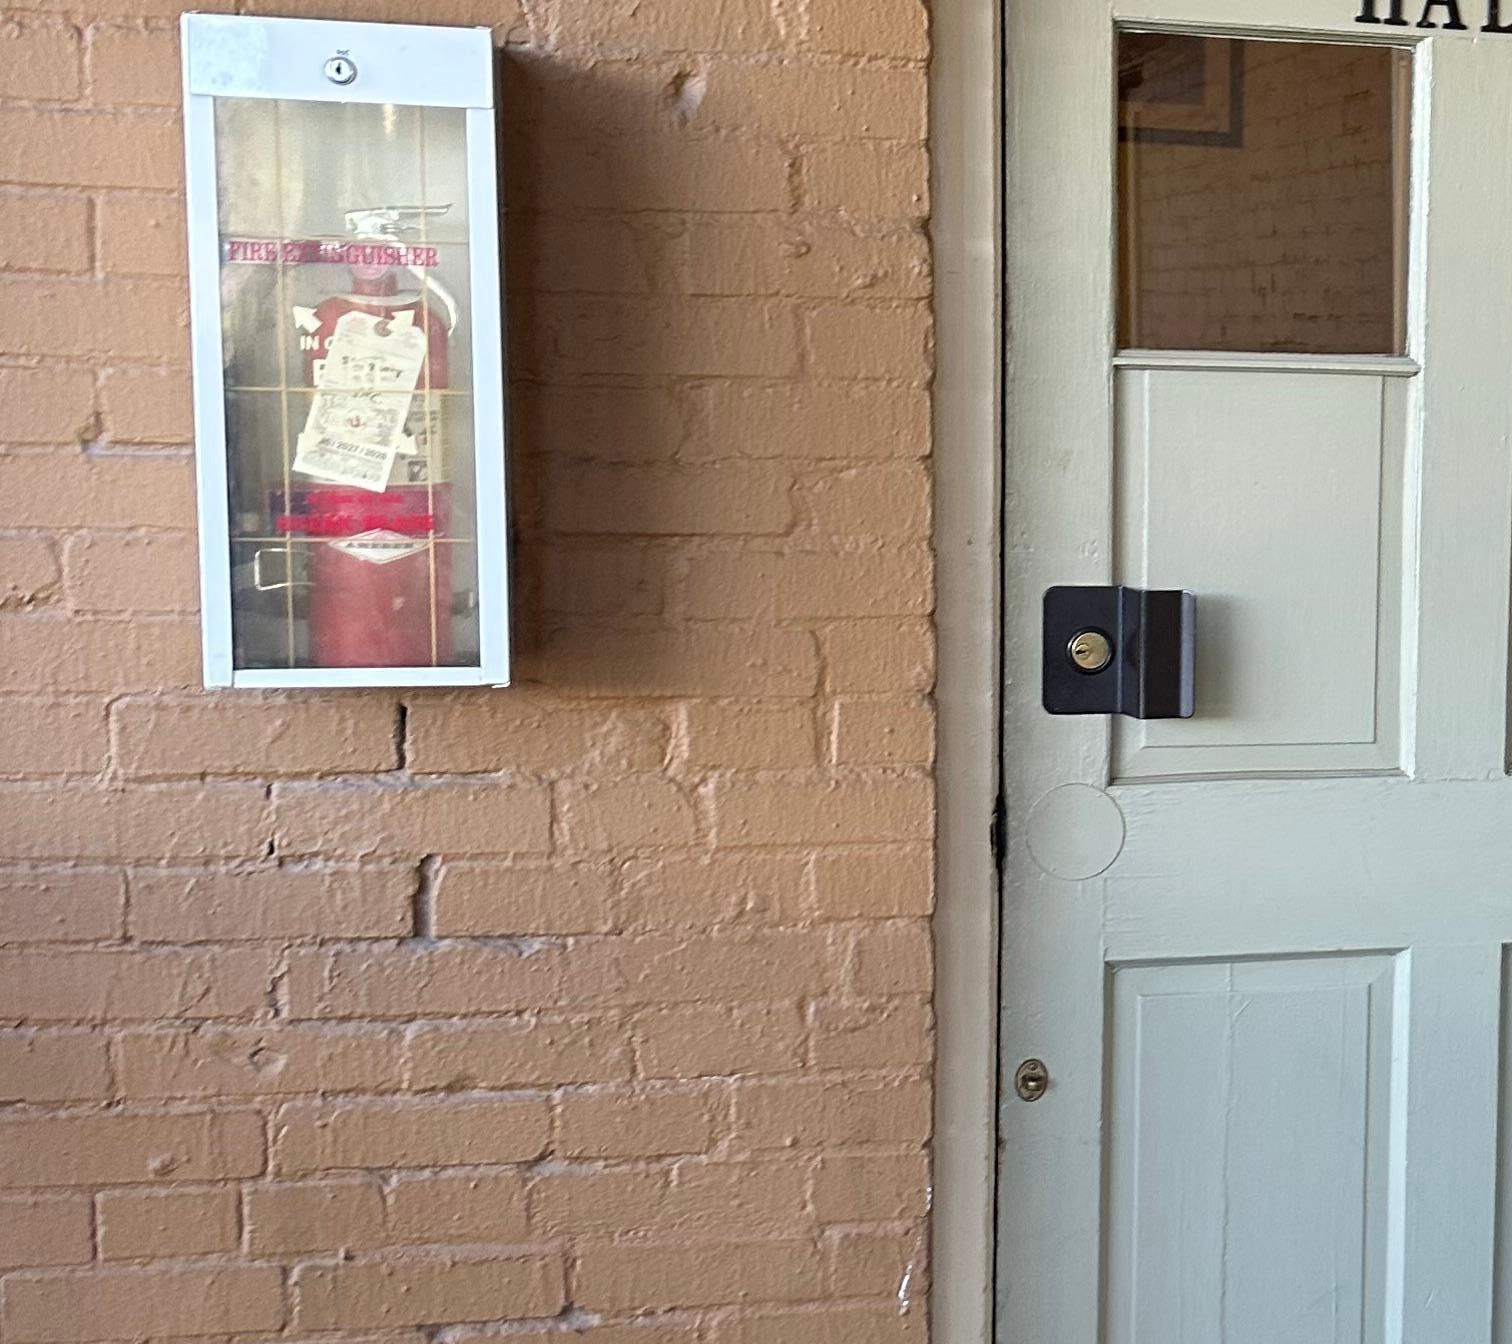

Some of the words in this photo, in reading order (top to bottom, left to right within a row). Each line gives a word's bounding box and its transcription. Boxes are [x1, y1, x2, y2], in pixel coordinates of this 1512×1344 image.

[228, 240, 277, 262] FIRE
[282, 239, 440, 268] EGUISHER
[299, 334, 320, 351] IN
